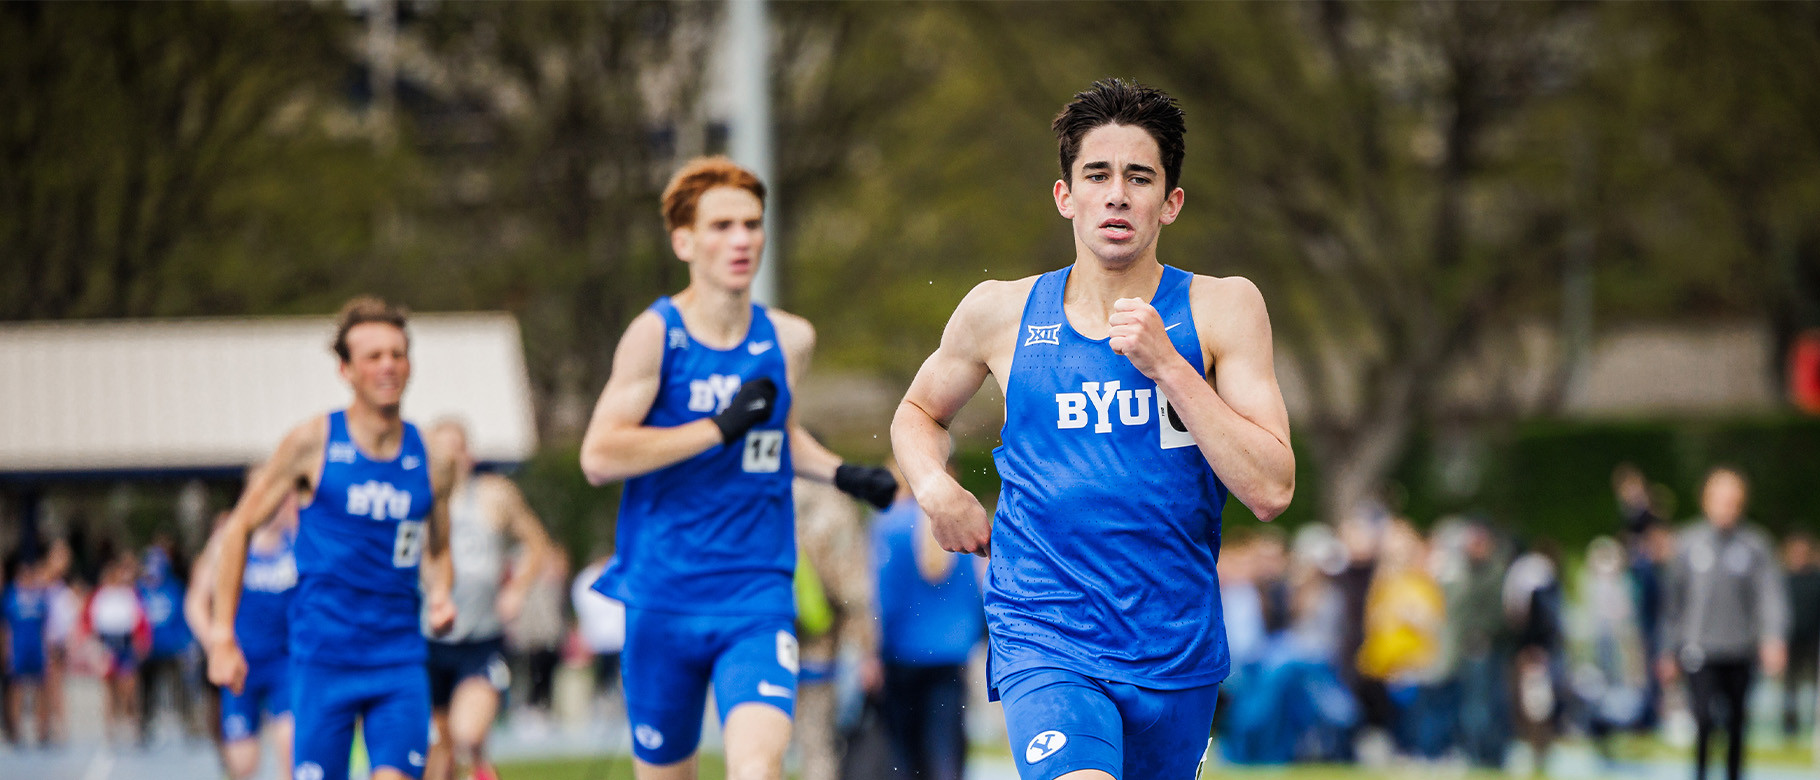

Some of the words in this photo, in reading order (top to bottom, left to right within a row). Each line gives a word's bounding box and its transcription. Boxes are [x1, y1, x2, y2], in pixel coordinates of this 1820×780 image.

[1026, 325, 1060, 344] XII
[688, 373, 742, 416] BY
[1055, 380, 1152, 434] BYU
[1030, 734, 1055, 755] Y
